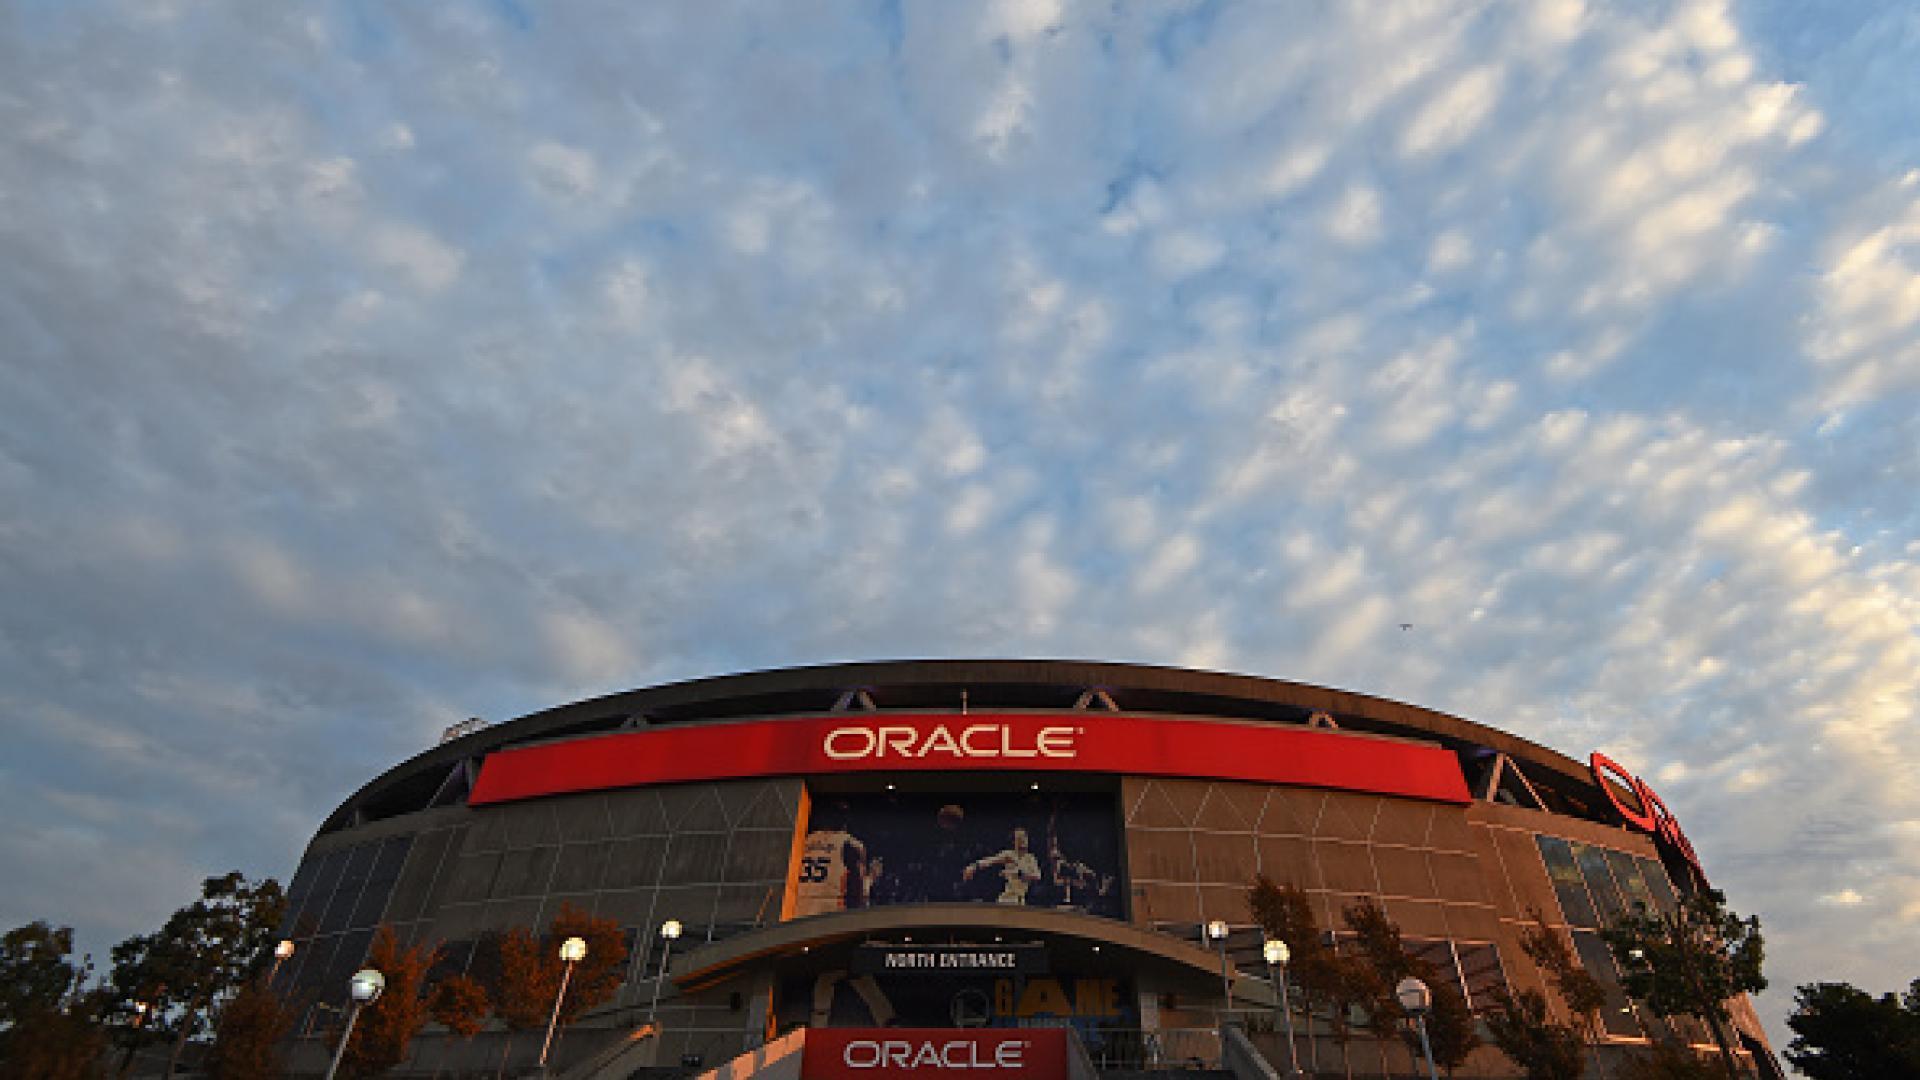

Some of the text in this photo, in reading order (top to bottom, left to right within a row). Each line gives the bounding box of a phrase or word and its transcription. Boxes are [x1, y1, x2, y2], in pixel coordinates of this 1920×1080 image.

[823, 724, 1078, 760] ORACLE
[799, 856, 832, 883] 35
[885, 953, 1016, 968] NORTH ENTRANCE
[843, 1040, 1025, 1069] ORACLE
